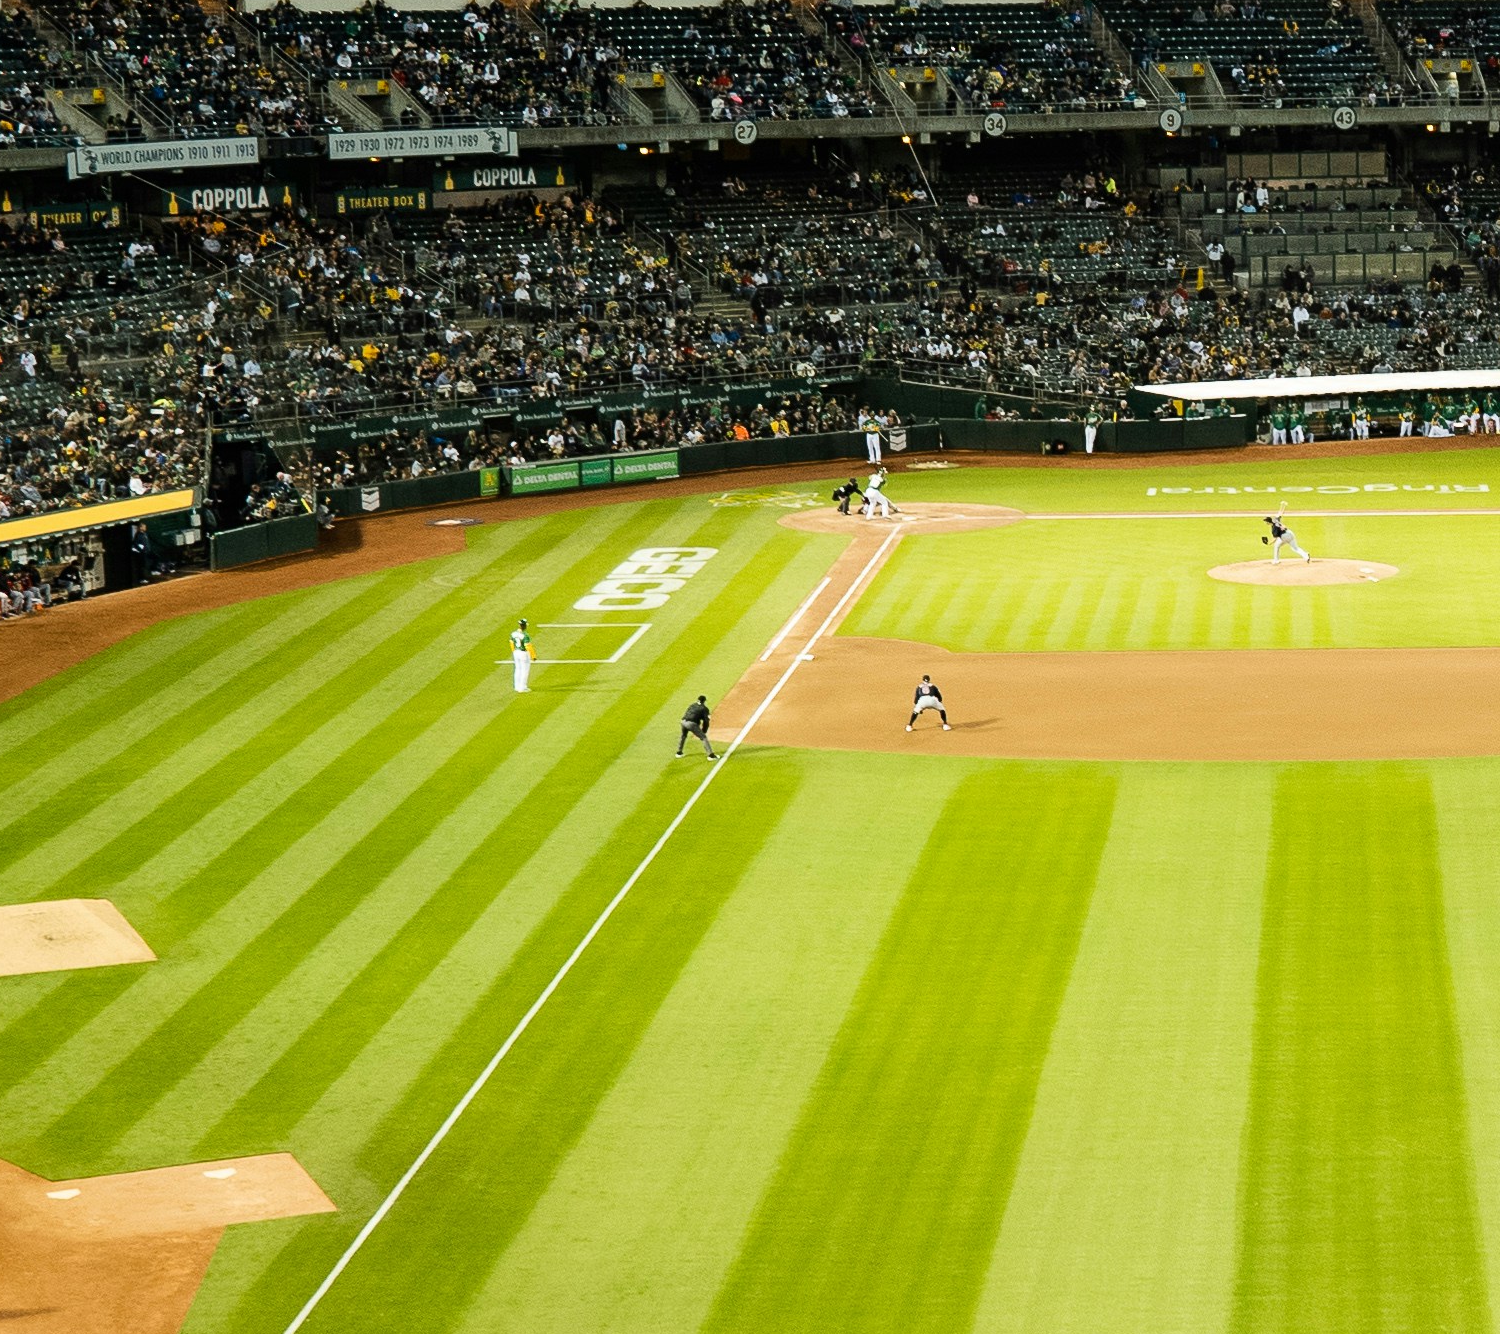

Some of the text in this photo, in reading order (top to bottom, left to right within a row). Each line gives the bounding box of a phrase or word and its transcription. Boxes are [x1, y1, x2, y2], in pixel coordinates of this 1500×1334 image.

[987, 117, 1004, 132] 34
[1167, 114, 1175, 127] 9
[1336, 111, 1353, 125] 43
[737, 124, 754, 139] 27
[334, 134, 479, 154] 1929 1930 1972 1973 1974 1989
[100, 143, 256, 166] WORLD CHAMPIONS 1910 1911 1913
[472, 166, 537, 188] COPPOLA
[191, 185, 270, 211] COPPOLA
[349, 194, 414, 209] THEATER BOX
[624, 460, 678, 474] DELTA DENTAL
[524, 470, 579, 485] DELTA DENTAL
[1145, 483, 1491, 497] RingCentral
[572, 546, 720, 611] GEICO
